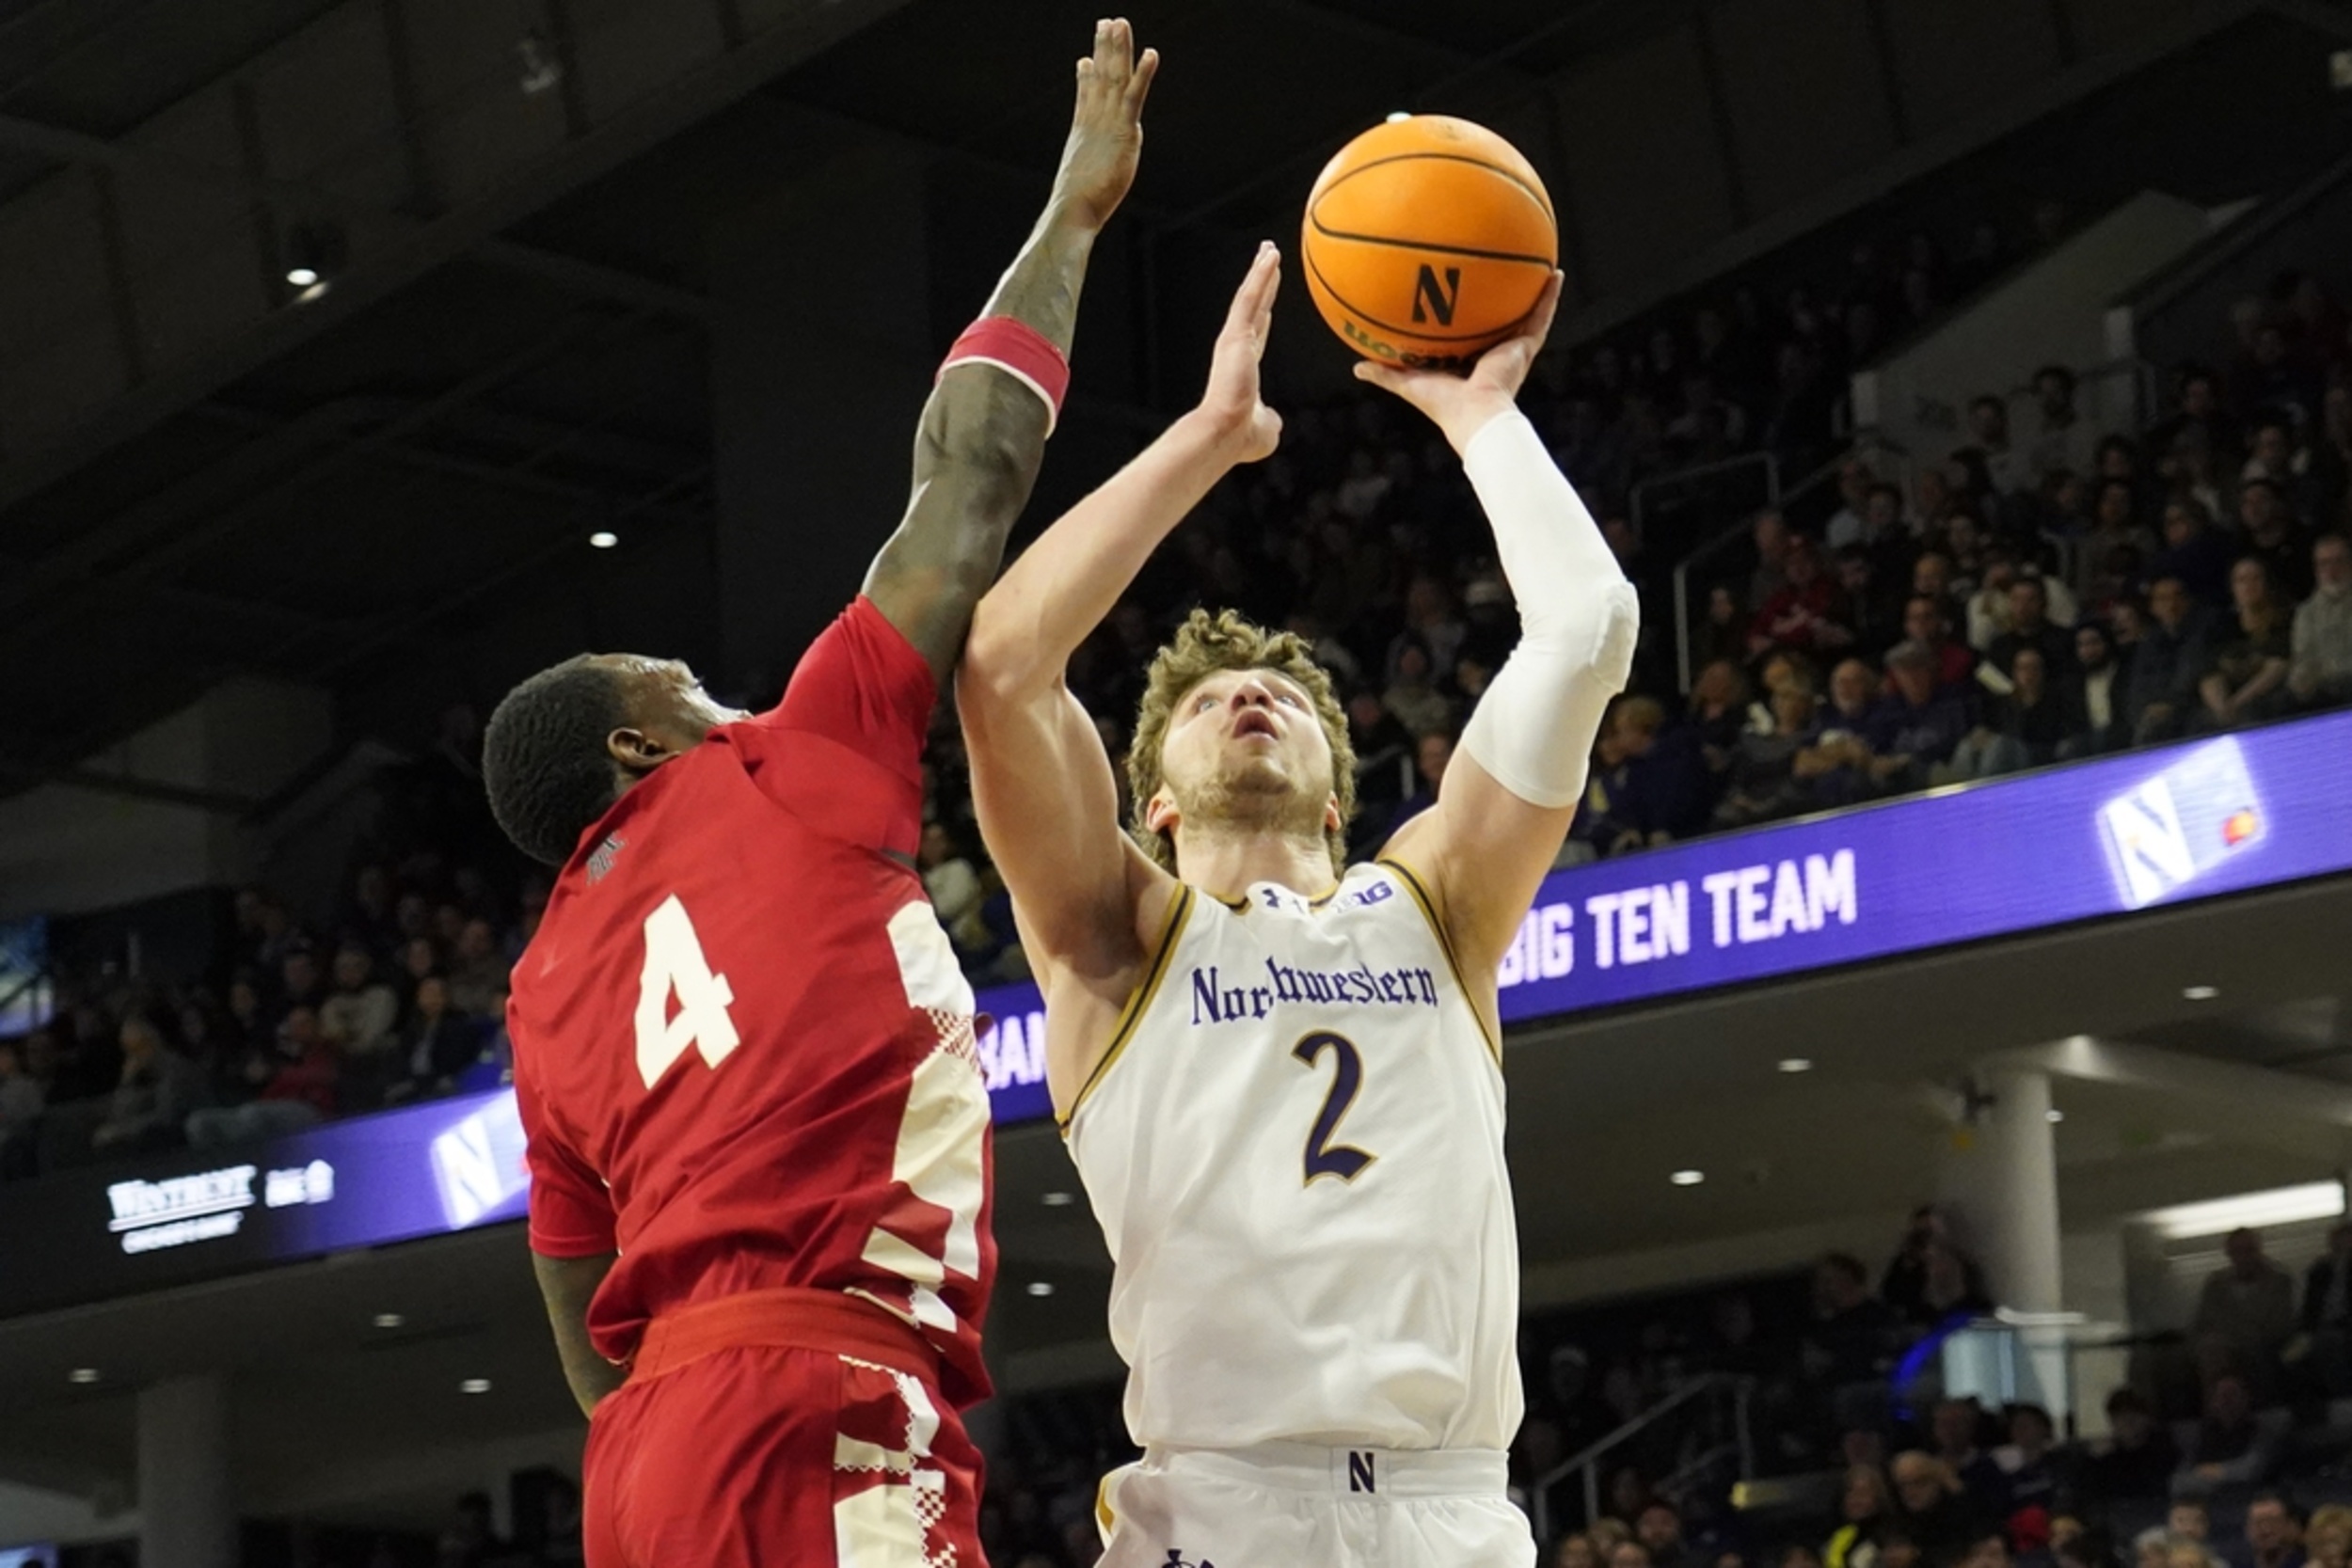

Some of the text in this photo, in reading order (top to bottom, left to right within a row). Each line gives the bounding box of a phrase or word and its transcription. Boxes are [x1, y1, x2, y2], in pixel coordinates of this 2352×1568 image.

[1412, 263, 1461, 326] N
[1585, 879, 1691, 970] TEN
[1702, 847, 1857, 949] TEAM
[633, 891, 741, 1092] 4
[1191, 954, 1439, 1026] Norhwestern
[1290, 1028, 1380, 1190] 2
[1349, 1449, 1375, 1494] N
